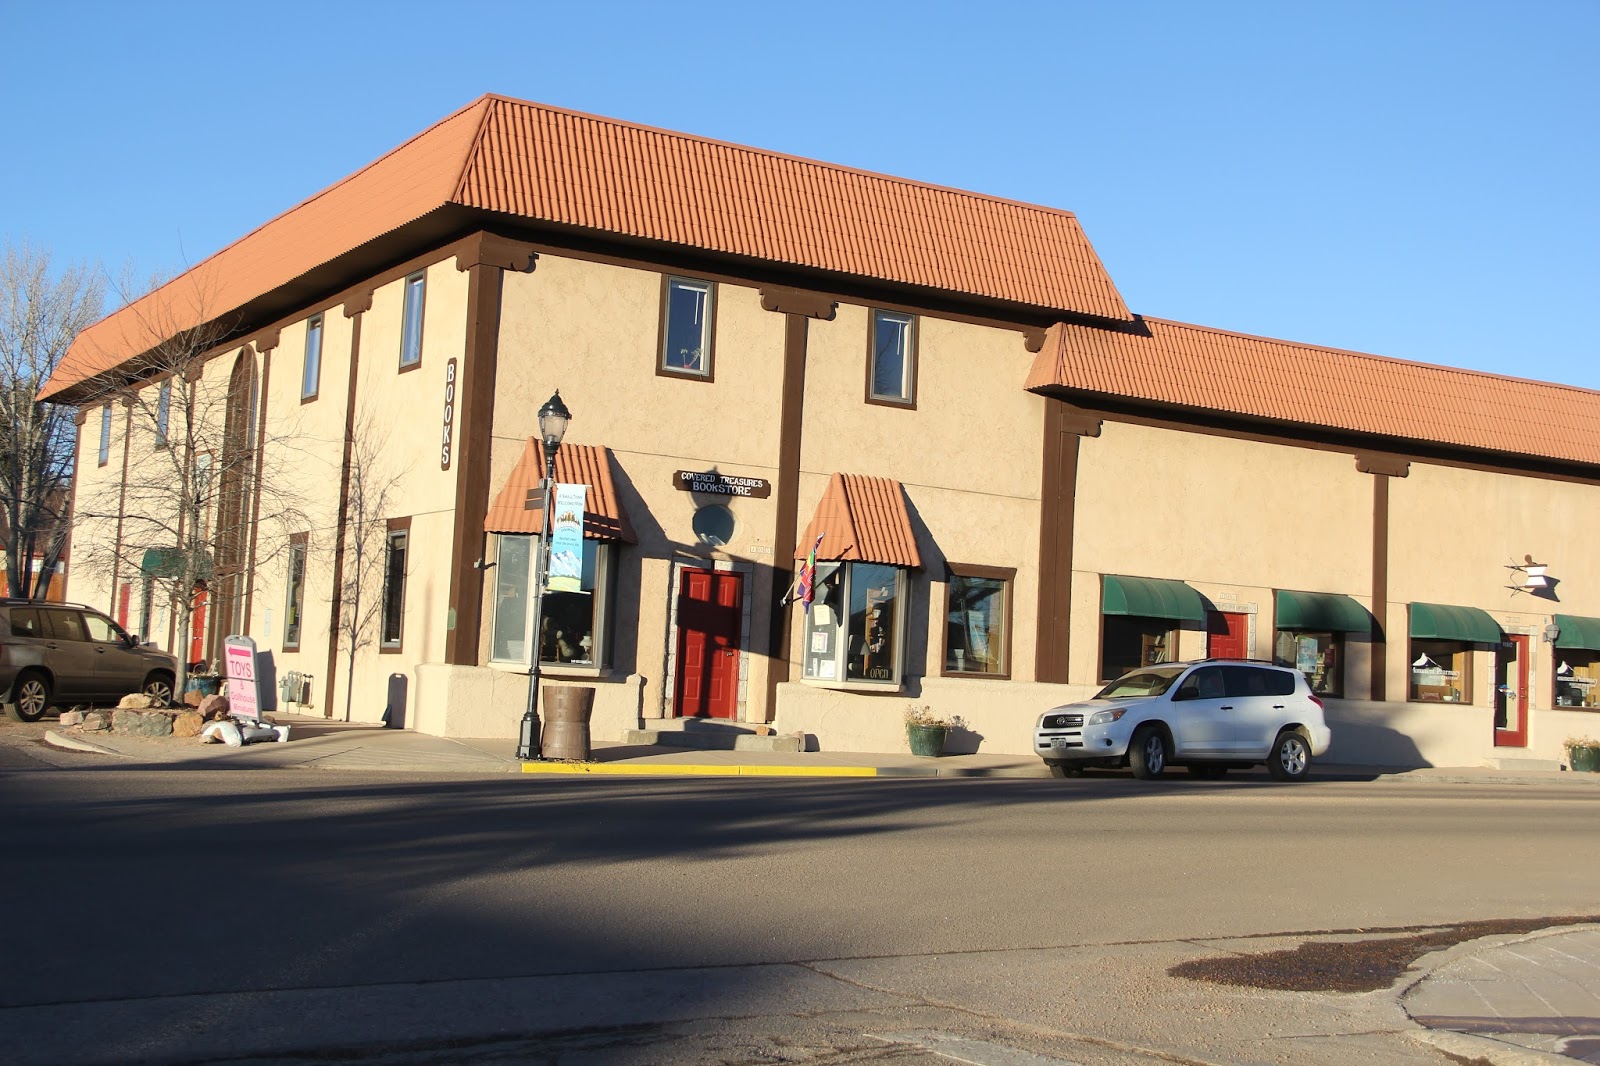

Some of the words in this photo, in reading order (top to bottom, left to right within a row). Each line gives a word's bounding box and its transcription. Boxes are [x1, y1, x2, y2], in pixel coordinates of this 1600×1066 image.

[442, 364, 455, 464] BOOKS
[681, 472, 715, 482] COVERED
[720, 476, 763, 488] TREASURES
[693, 481, 751, 496] BOOKSTORE
[230, 661, 251, 677] TOYS
